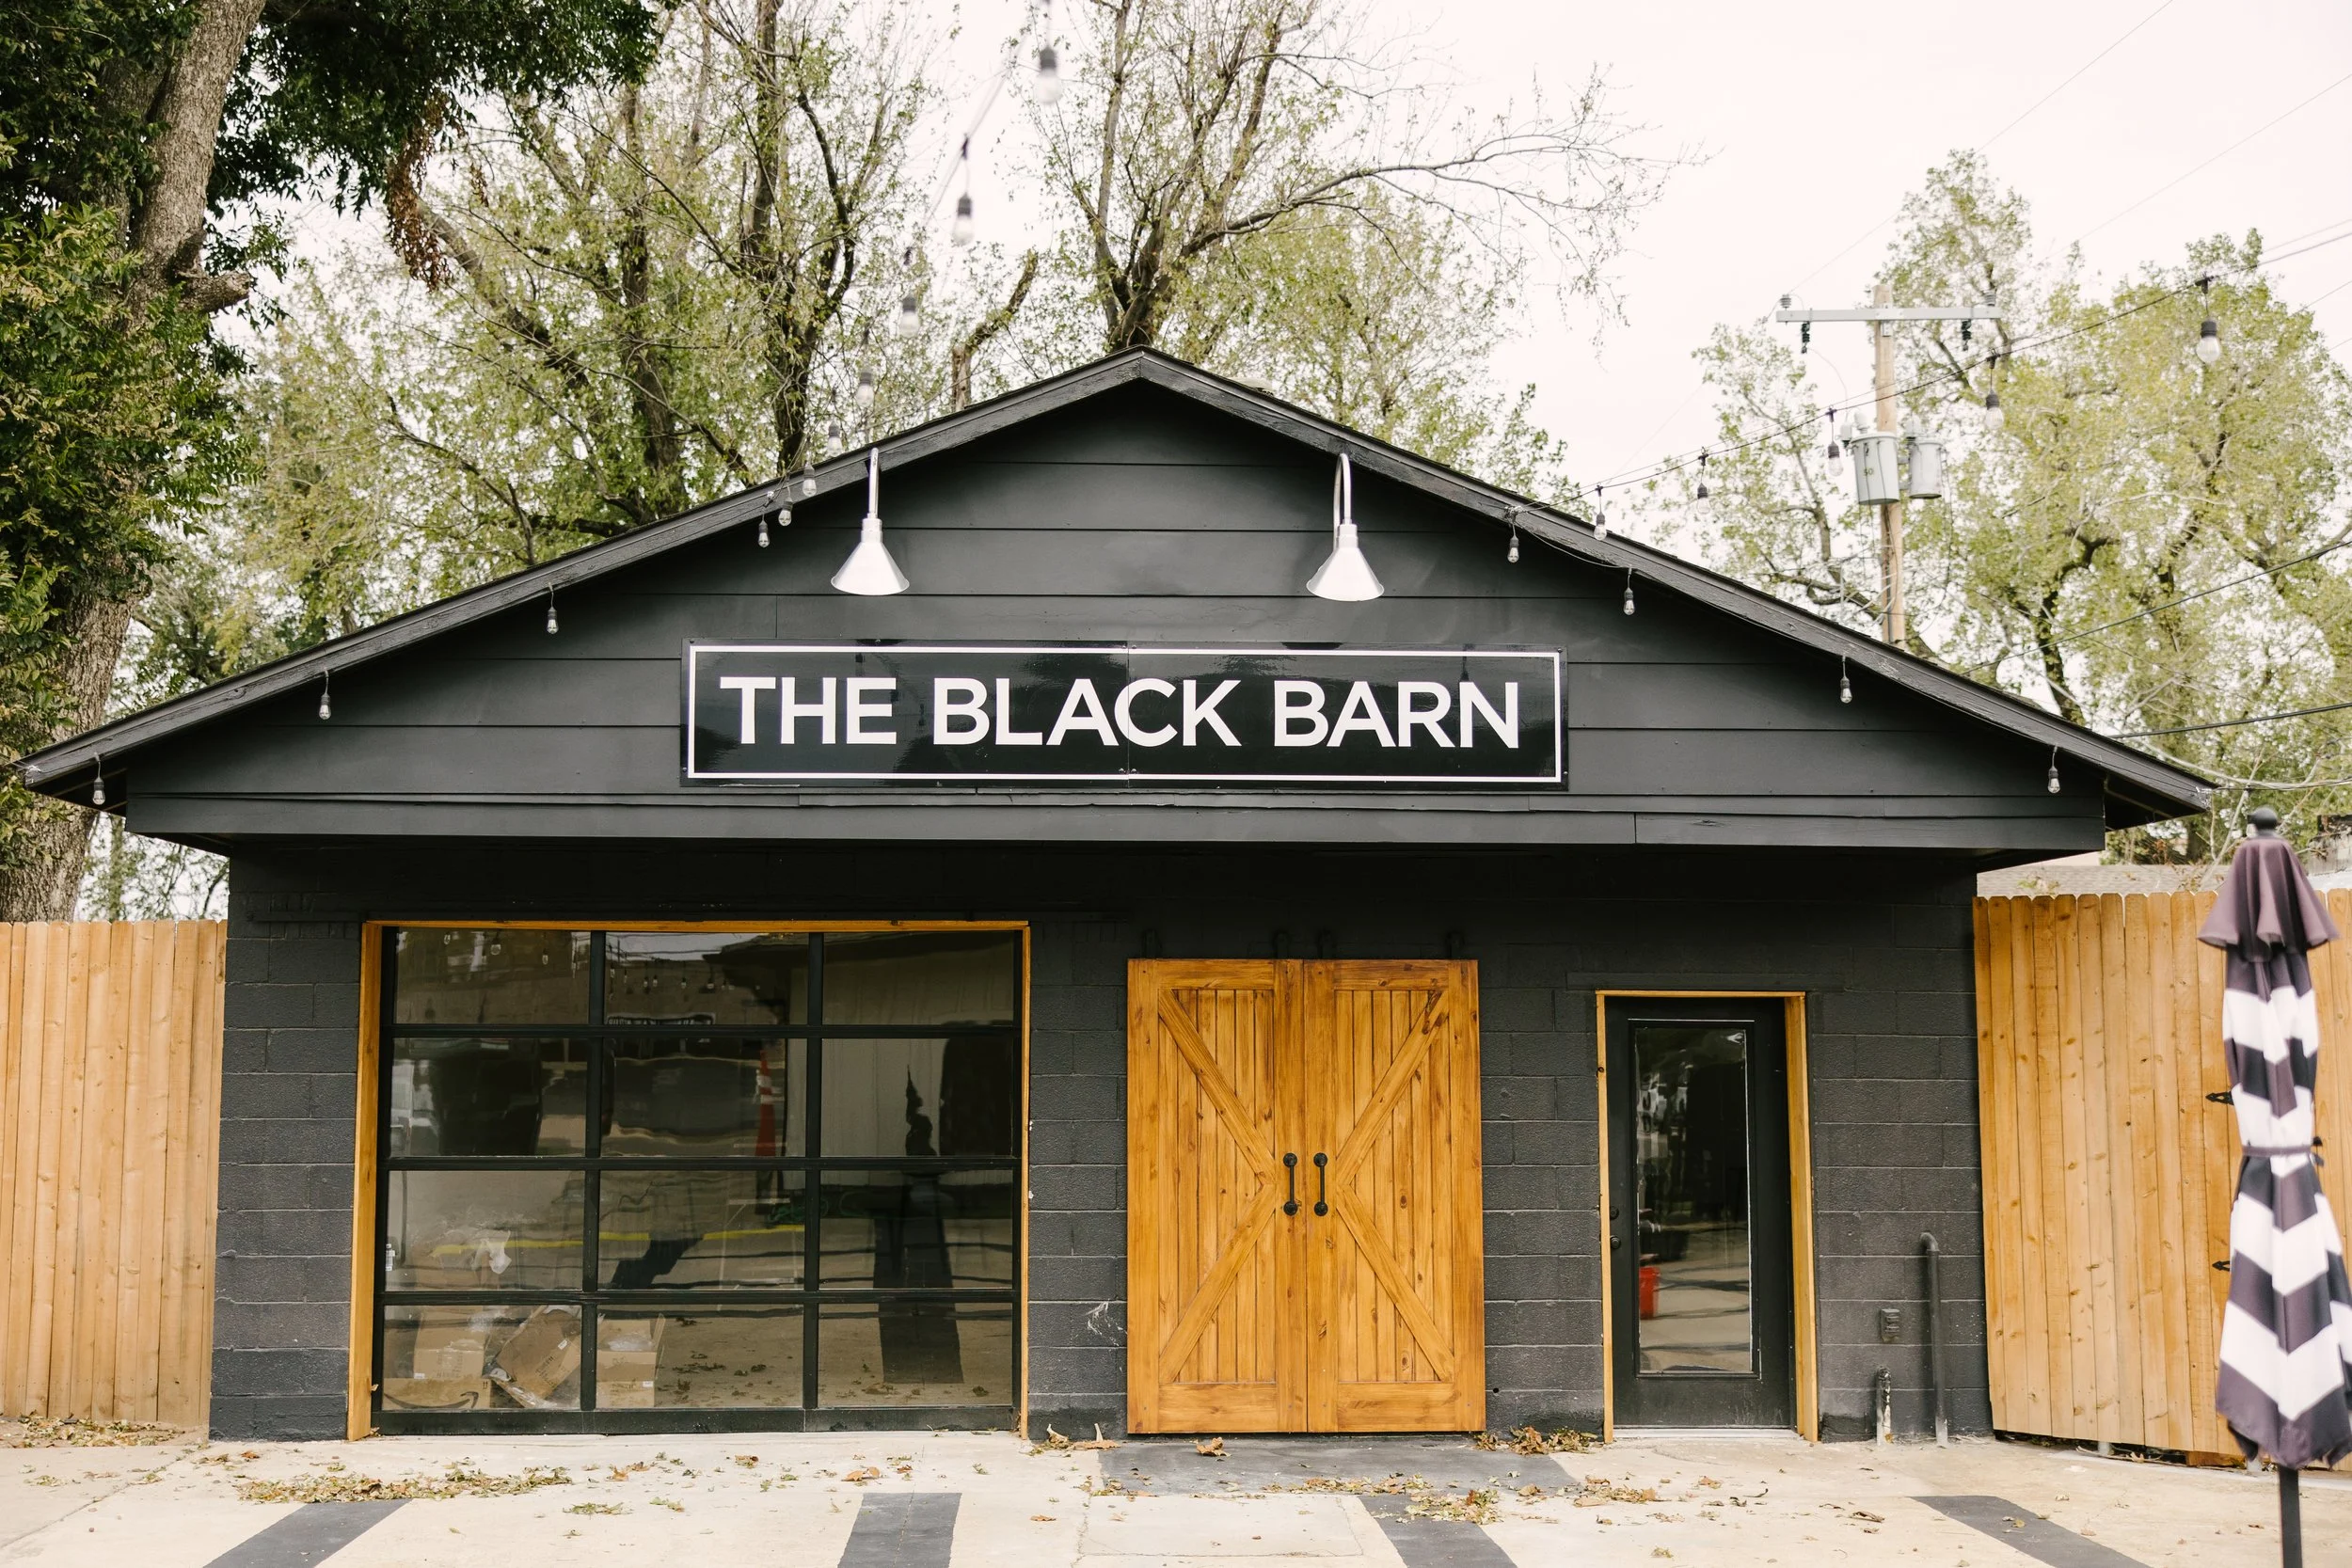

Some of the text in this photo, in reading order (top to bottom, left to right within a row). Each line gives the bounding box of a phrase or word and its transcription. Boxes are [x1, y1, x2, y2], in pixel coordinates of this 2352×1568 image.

[720, 676, 1519, 749] THE BLACK BARN
